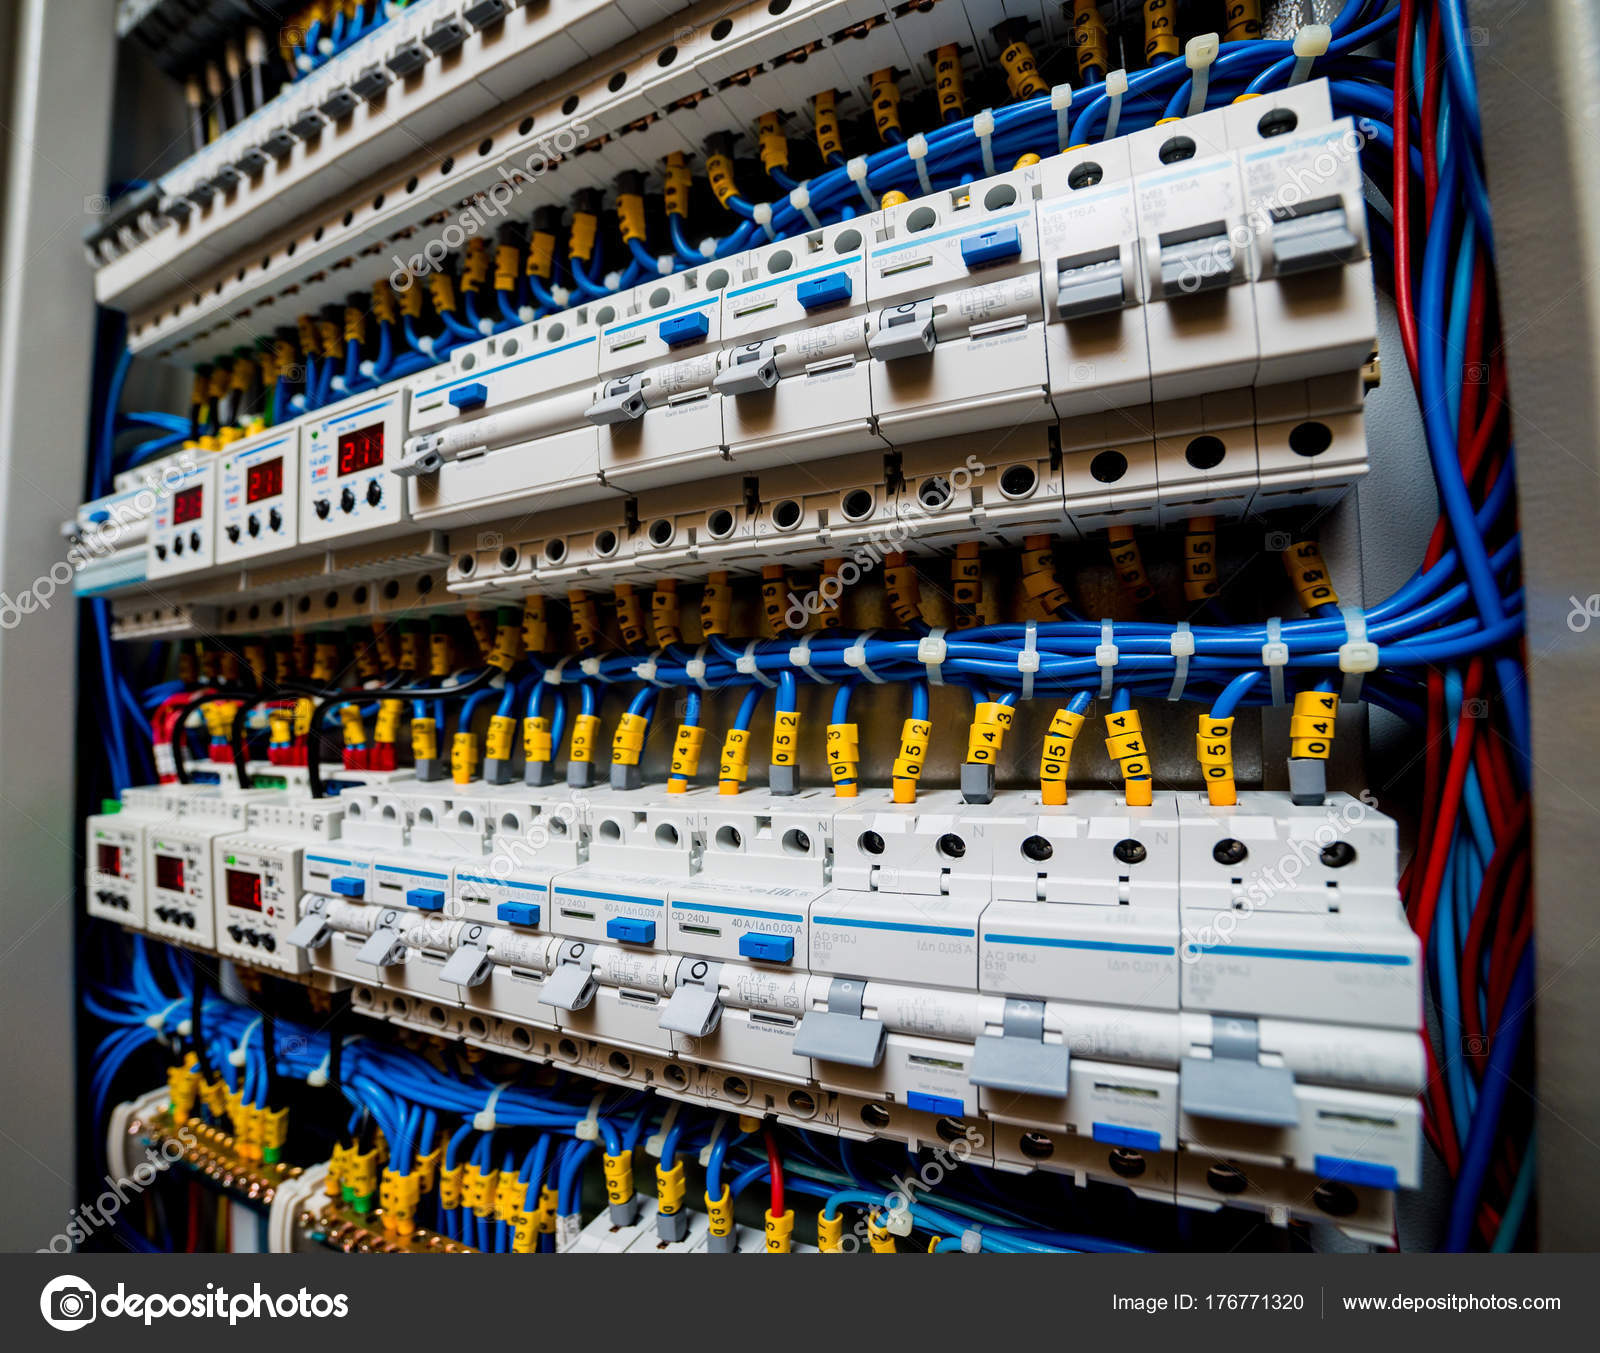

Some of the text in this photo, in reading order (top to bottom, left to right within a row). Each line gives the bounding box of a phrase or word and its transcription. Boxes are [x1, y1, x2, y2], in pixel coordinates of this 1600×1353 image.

[775, 716, 797, 763] 052
[974, 712, 1012, 760] 043
[1308, 696, 1335, 754] 044
[721, 734, 744, 774] 045
[828, 730, 848, 775] 043
[906, 723, 929, 775] 052
[1045, 718, 1073, 774] 051
[1112, 716, 1144, 774] 044
[1206, 726, 1229, 778] 050
[686, 815, 694, 827] N
[817, 820, 828, 833] N
[973, 824, 985, 838] N
[1156, 831, 1168, 845] N
[671, 911, 686, 921] CD
[687, 912, 710, 925] 240J
[731, 918, 743, 929] 40
[813, 940, 833, 951] B10
[832, 932, 857, 944] 910J
[710, 1087, 718, 1098] 2
[825, 1112, 834, 1124] N
